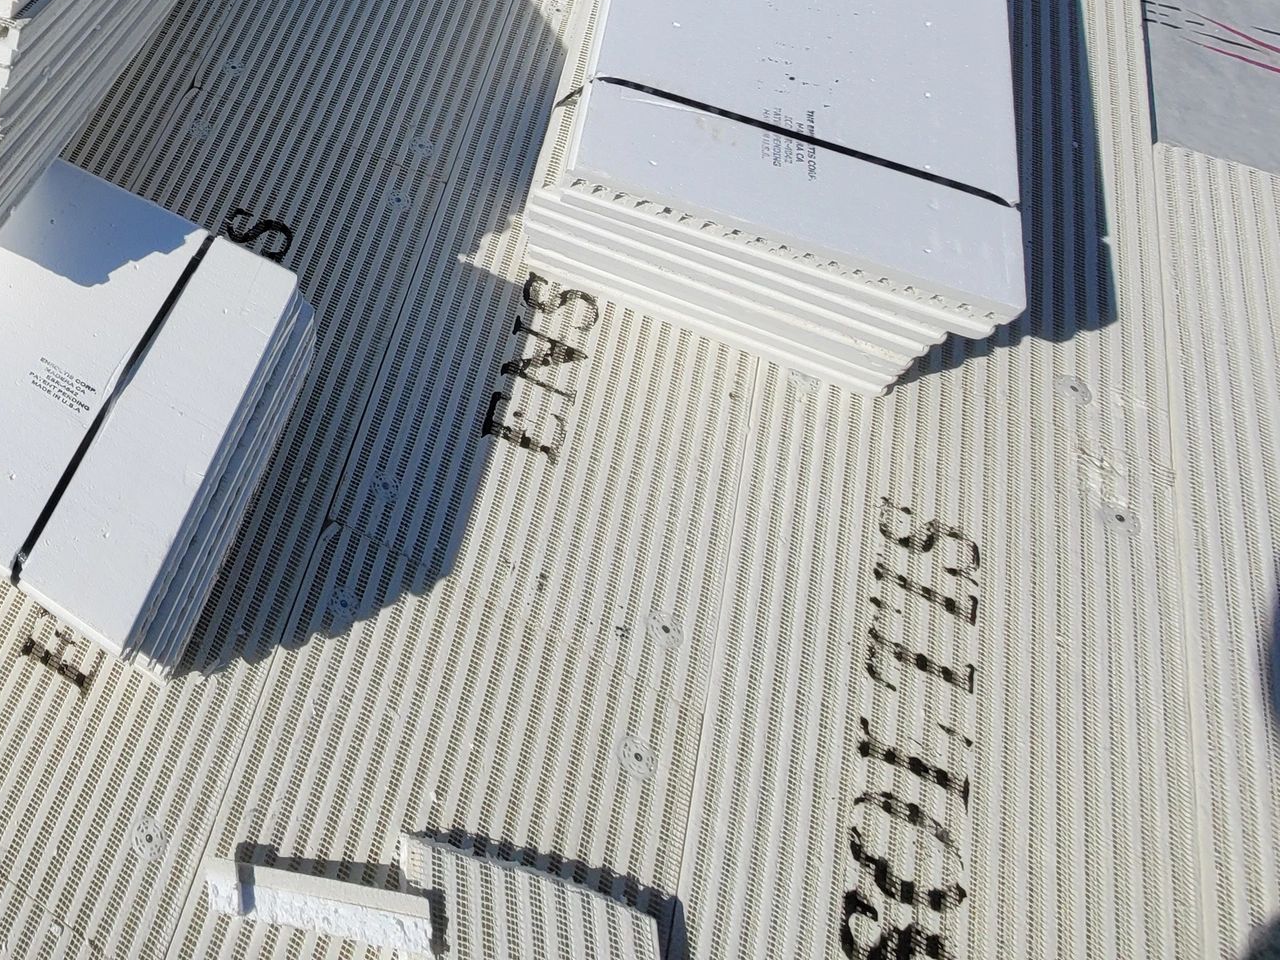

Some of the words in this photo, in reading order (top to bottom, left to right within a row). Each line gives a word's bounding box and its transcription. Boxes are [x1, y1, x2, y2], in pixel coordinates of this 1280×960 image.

[29, 370, 58, 391] PATENT
[57, 387, 91, 412] PENDING
[31, 379, 53, 395] MADE
[75, 377, 97, 395] CORP.
[75, 385, 87, 395] CA
